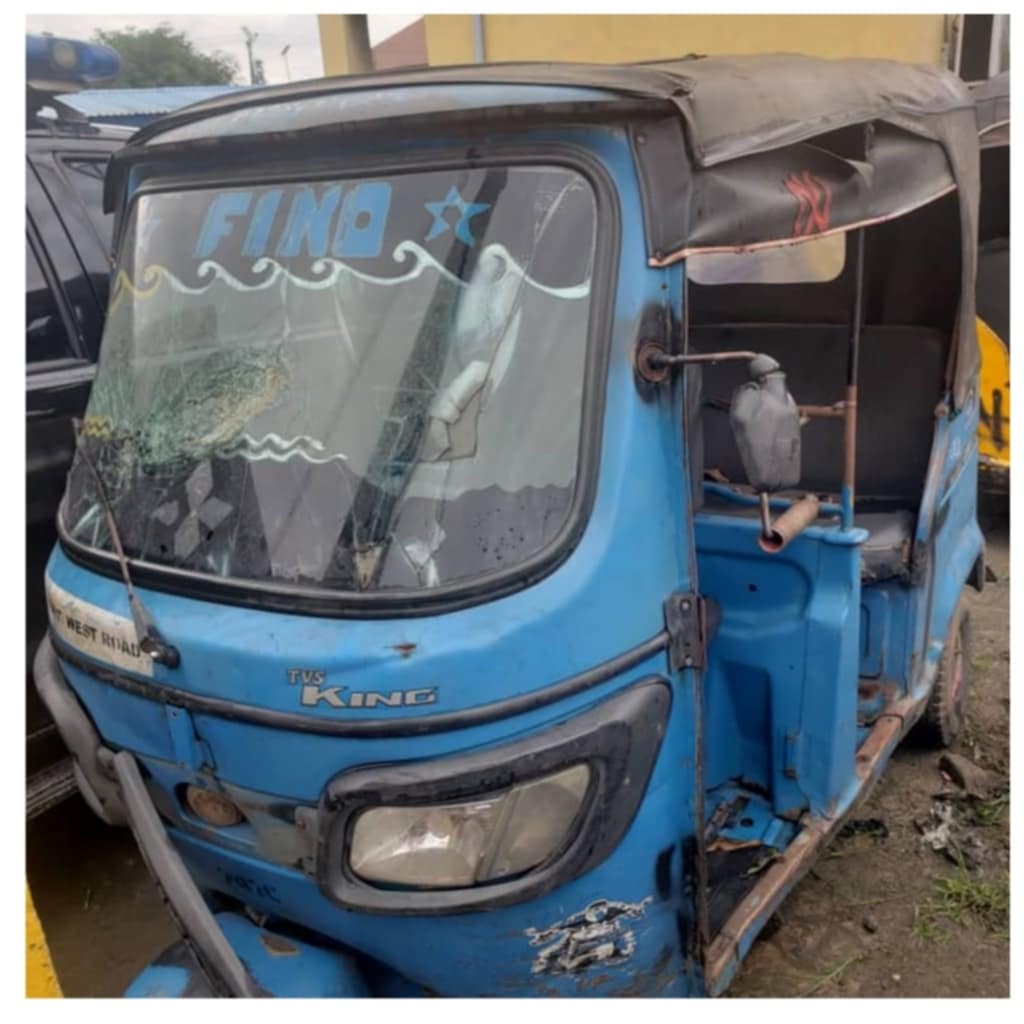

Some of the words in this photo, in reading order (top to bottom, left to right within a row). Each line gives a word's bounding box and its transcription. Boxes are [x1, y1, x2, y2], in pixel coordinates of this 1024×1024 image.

[194, 180, 393, 259] FINO
[65, 615, 98, 641] WEST
[287, 667, 326, 687] TVS
[300, 684, 439, 709] KING
